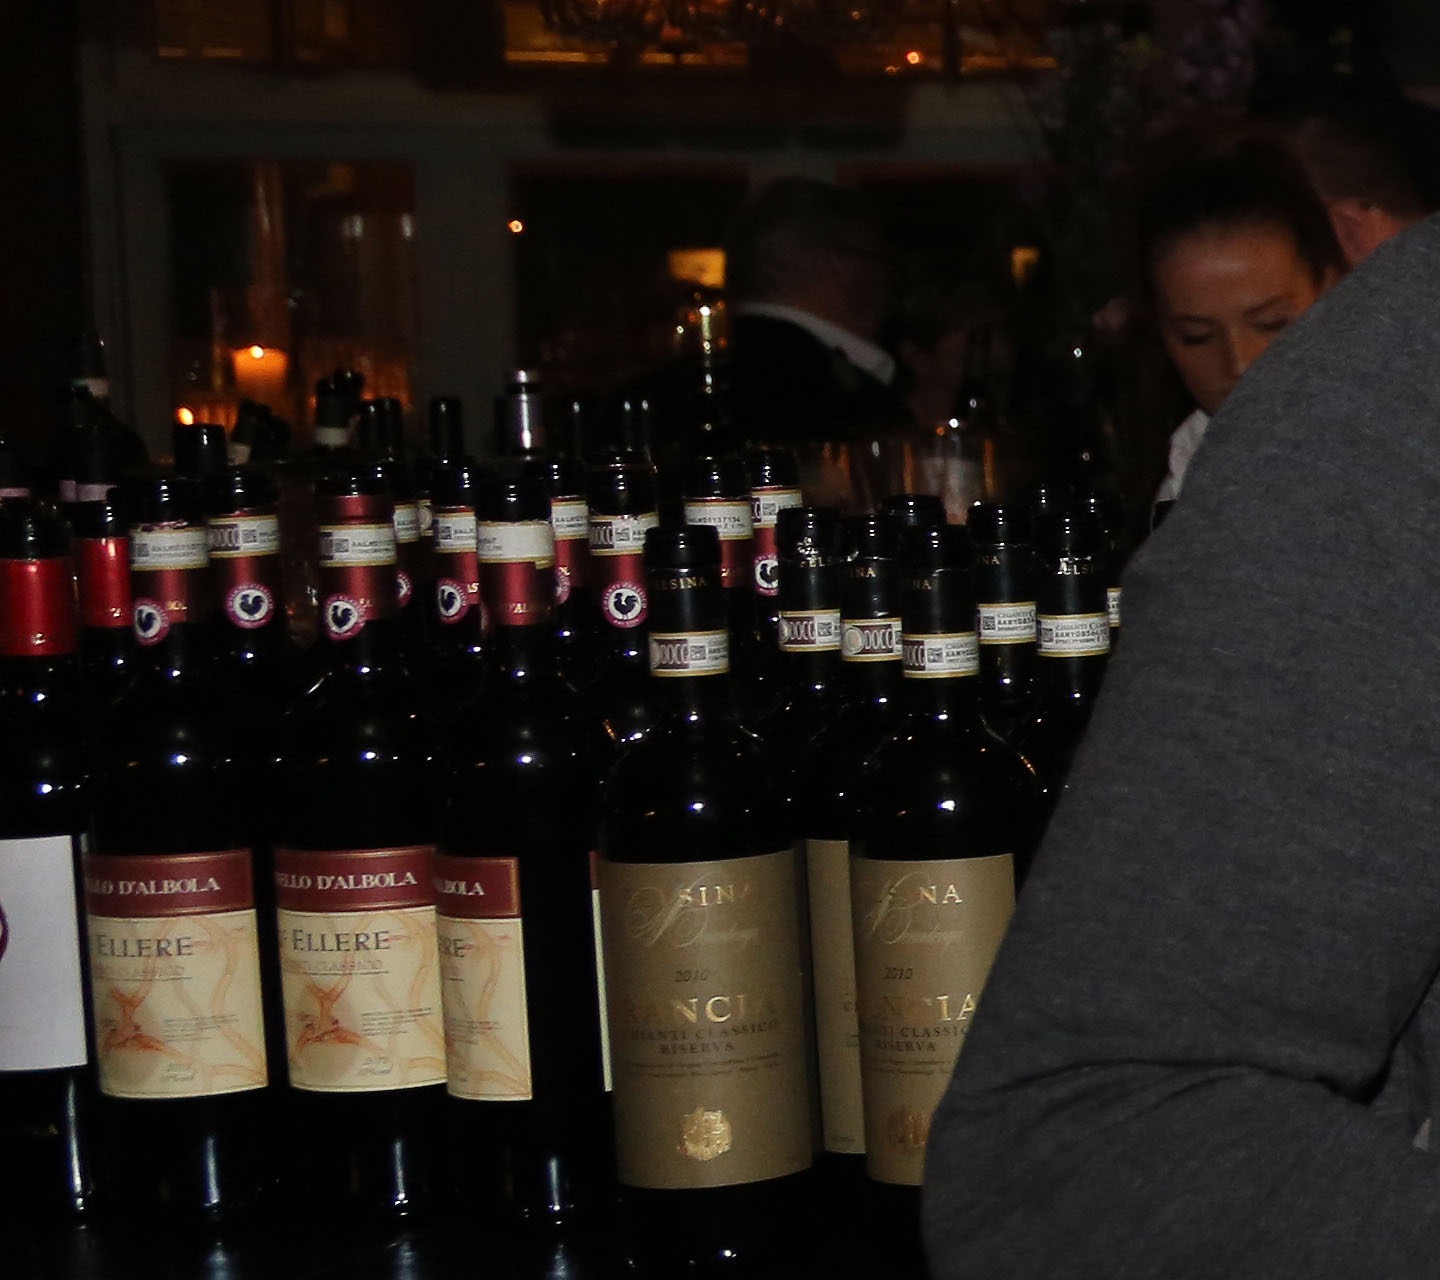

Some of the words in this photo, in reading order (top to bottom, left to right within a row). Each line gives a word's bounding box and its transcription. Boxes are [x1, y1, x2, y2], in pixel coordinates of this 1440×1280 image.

[119, 876, 221, 896] D'ALBOLA
[316, 871, 418, 891] D'ALBOLA
[96, 933, 194, 958] ELLERE
[291, 929, 392, 952] ELLERE
